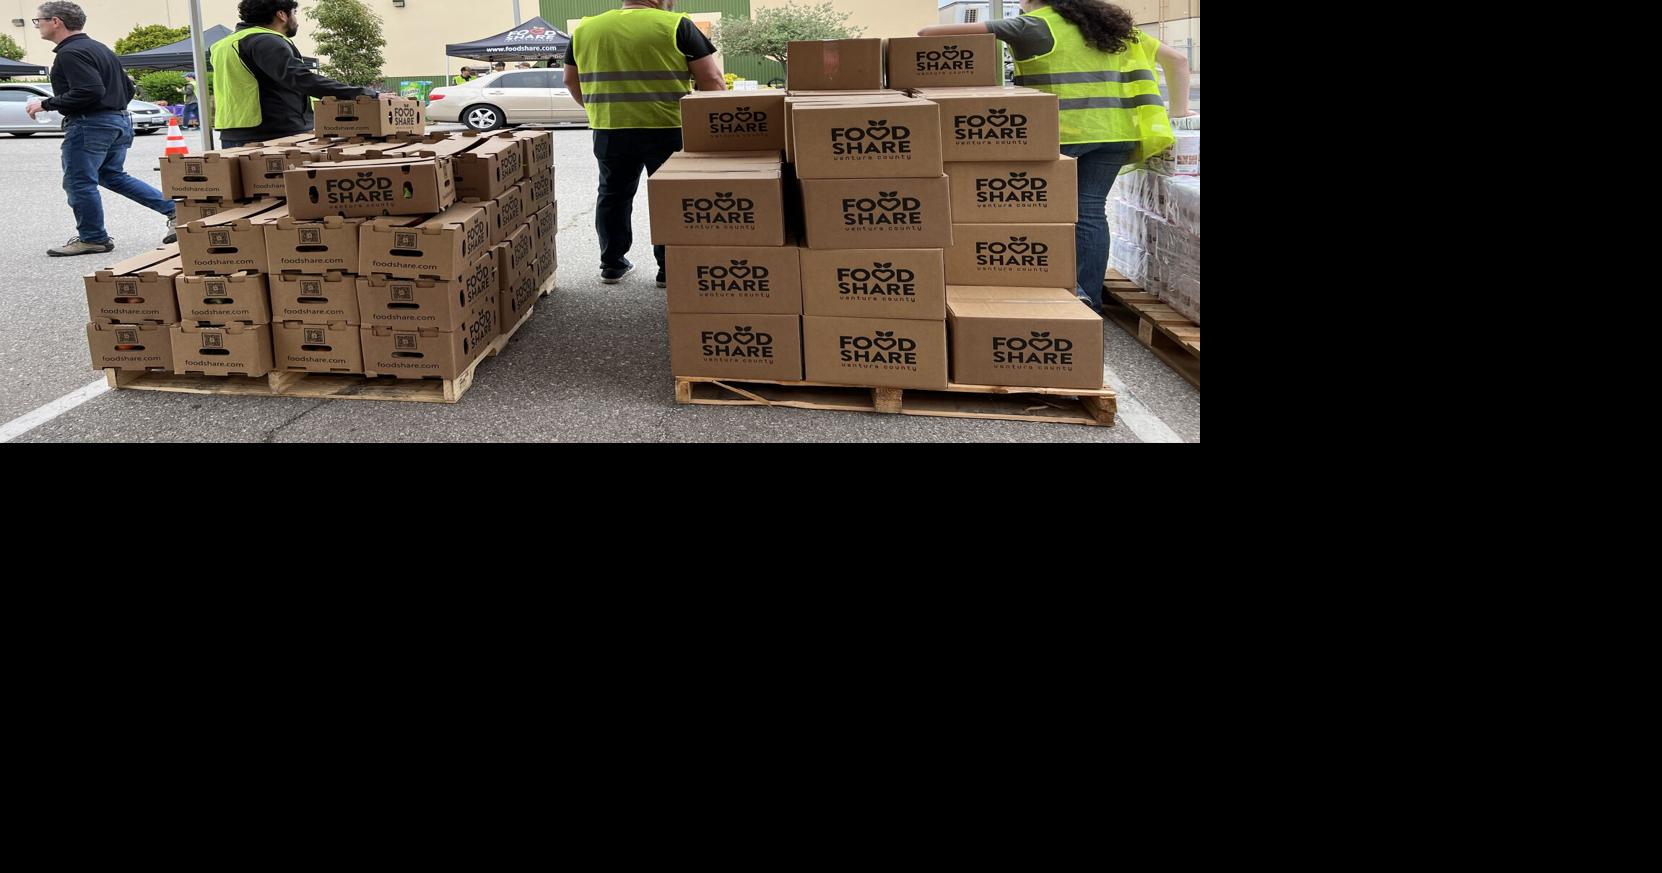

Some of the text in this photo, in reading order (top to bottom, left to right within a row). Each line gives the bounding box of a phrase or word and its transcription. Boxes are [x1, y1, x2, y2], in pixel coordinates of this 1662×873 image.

[507, 28, 556, 37] FOOD
[916, 50, 974, 61] FOOD
[917, 61, 974, 71] SHARE
[394, 107, 414, 117] FOOD
[709, 112, 767, 123] FOOD
[394, 118, 414, 126] SHARE
[954, 114, 1027, 128] FOOD
[710, 123, 768, 133] SHARE
[831, 126, 910, 141] FOOD
[955, 128, 1027, 140] SHARE
[832, 141, 911, 154] SHARE
[326, 177, 392, 192] FOOD
[976, 178, 1047, 190] FOOD
[328, 190, 394, 203] SHARE
[977, 191, 1048, 202] SHARE
[682, 198, 754, 211] FOOD
[842, 198, 920, 212] FOOD
[684, 212, 754, 224] SHARE
[844, 212, 922, 225] SHARE
[976, 242, 1048, 254] FOOD
[372, 260, 437, 270] foodshare.com
[976, 254, 1048, 266] SHARE
[466, 266, 488, 290] FOOD
[697, 266, 768, 279] FOOD
[837, 268, 914, 282] FOOD
[468, 280, 490, 302] SHARE
[698, 279, 770, 291] SHARE
[838, 282, 915, 296] SHARE
[470, 310, 490, 338] FOOD
[472, 320, 492, 349] SHARE
[702, 331, 772, 345] FOOD
[840, 336, 916, 351] FOOD
[992, 337, 1072, 351] FOOD
[702, 344, 773, 358] SHARE
[841, 350, 916, 364] SHARE
[993, 351, 1072, 364] SHARE
[185, 360, 244, 368] foodshare.com
[288, 355, 346, 364] foodshare.com
